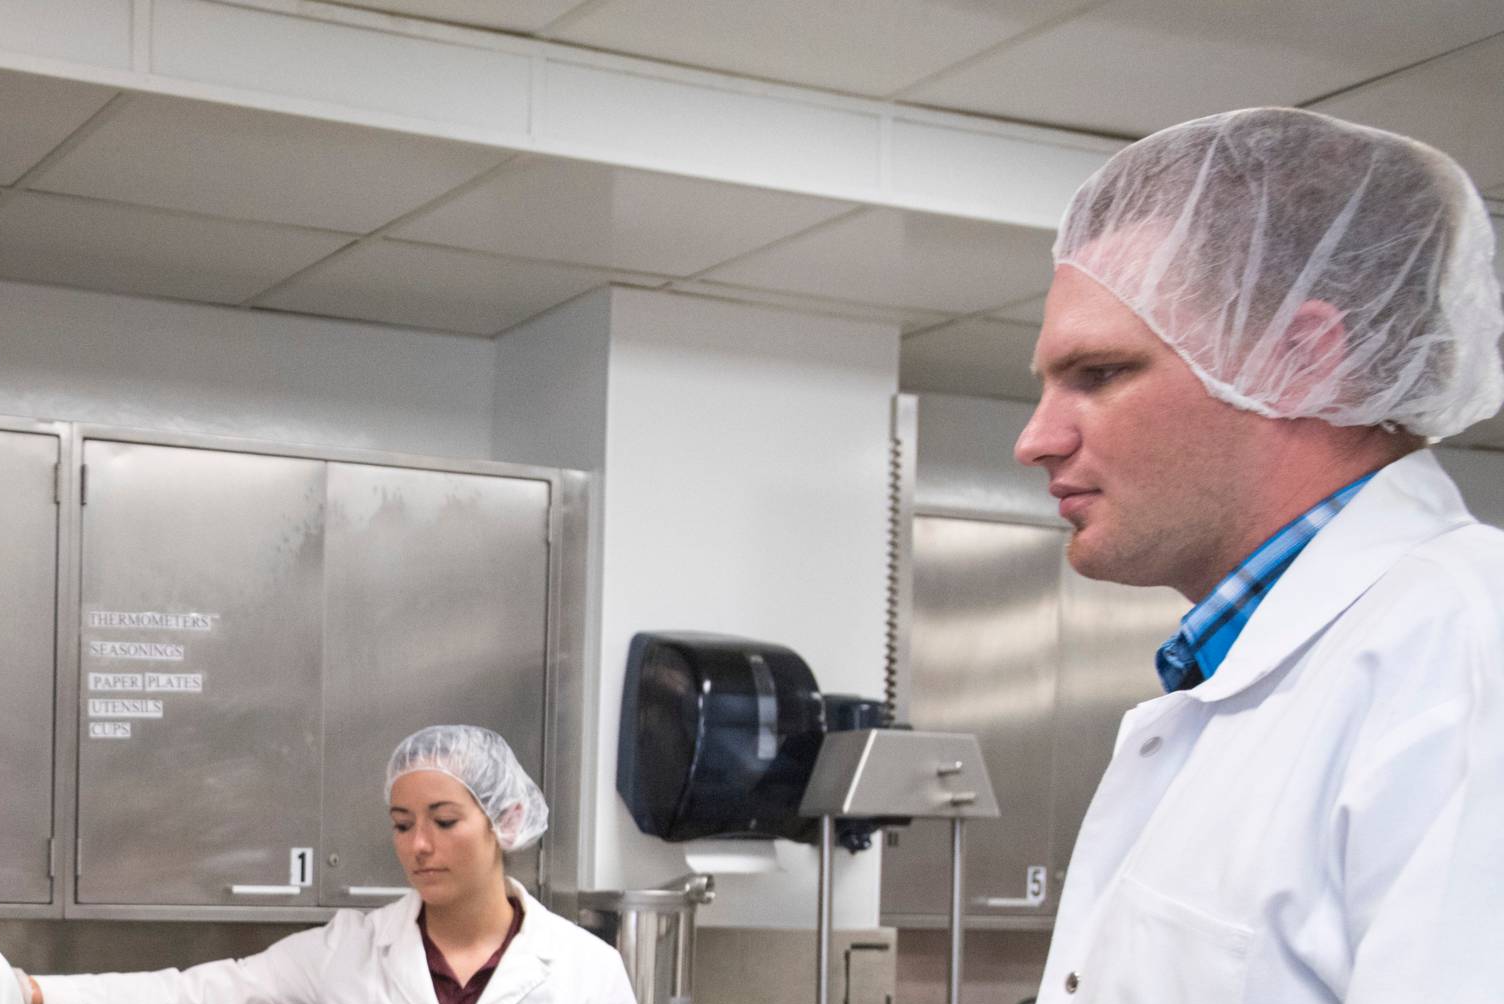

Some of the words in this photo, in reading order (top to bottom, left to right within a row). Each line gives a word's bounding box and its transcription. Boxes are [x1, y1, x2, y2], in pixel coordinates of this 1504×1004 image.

[90, 613, 209, 628] THERMOMETERS
[90, 643, 183, 657] SEASONINGS
[94, 675, 139, 689] PAPER
[148, 675, 201, 689] PLATES
[92, 700, 161, 713] UTENSILS
[92, 723, 129, 736] CUPS
[298, 851, 306, 883] 1
[1031, 868, 1042, 897] 5
